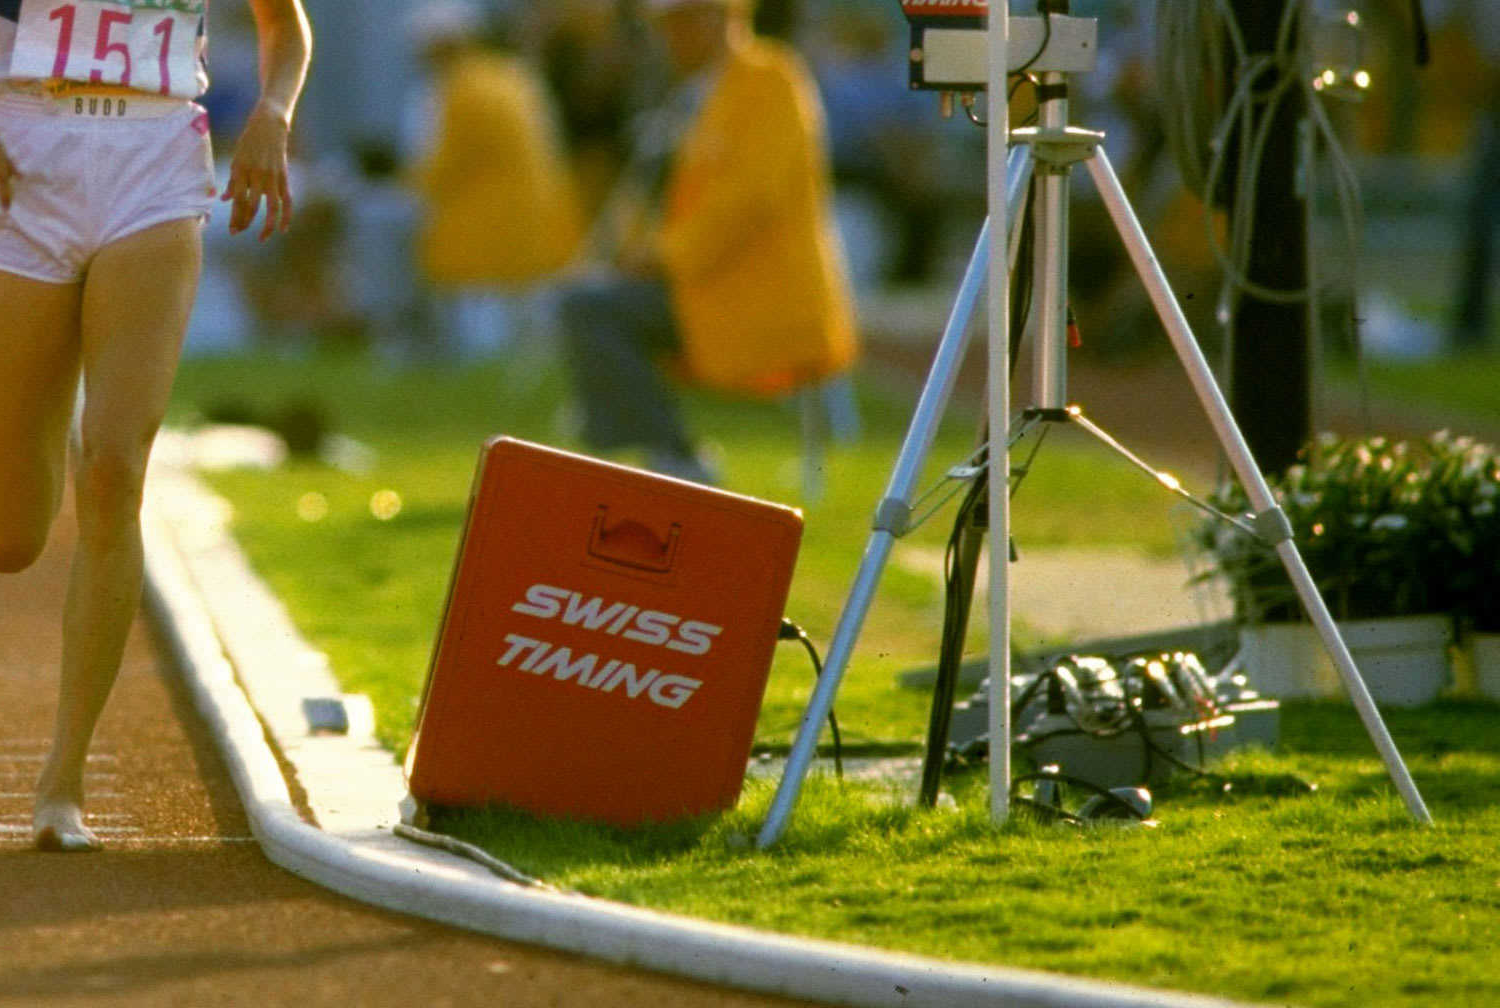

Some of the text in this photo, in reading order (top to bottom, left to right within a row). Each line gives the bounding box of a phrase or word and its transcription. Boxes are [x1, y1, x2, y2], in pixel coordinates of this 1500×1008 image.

[49, 4, 174, 96] 151
[75, 97, 126, 116] BUDD
[511, 584, 723, 655] SWISS
[497, 633, 703, 710] TIMING
